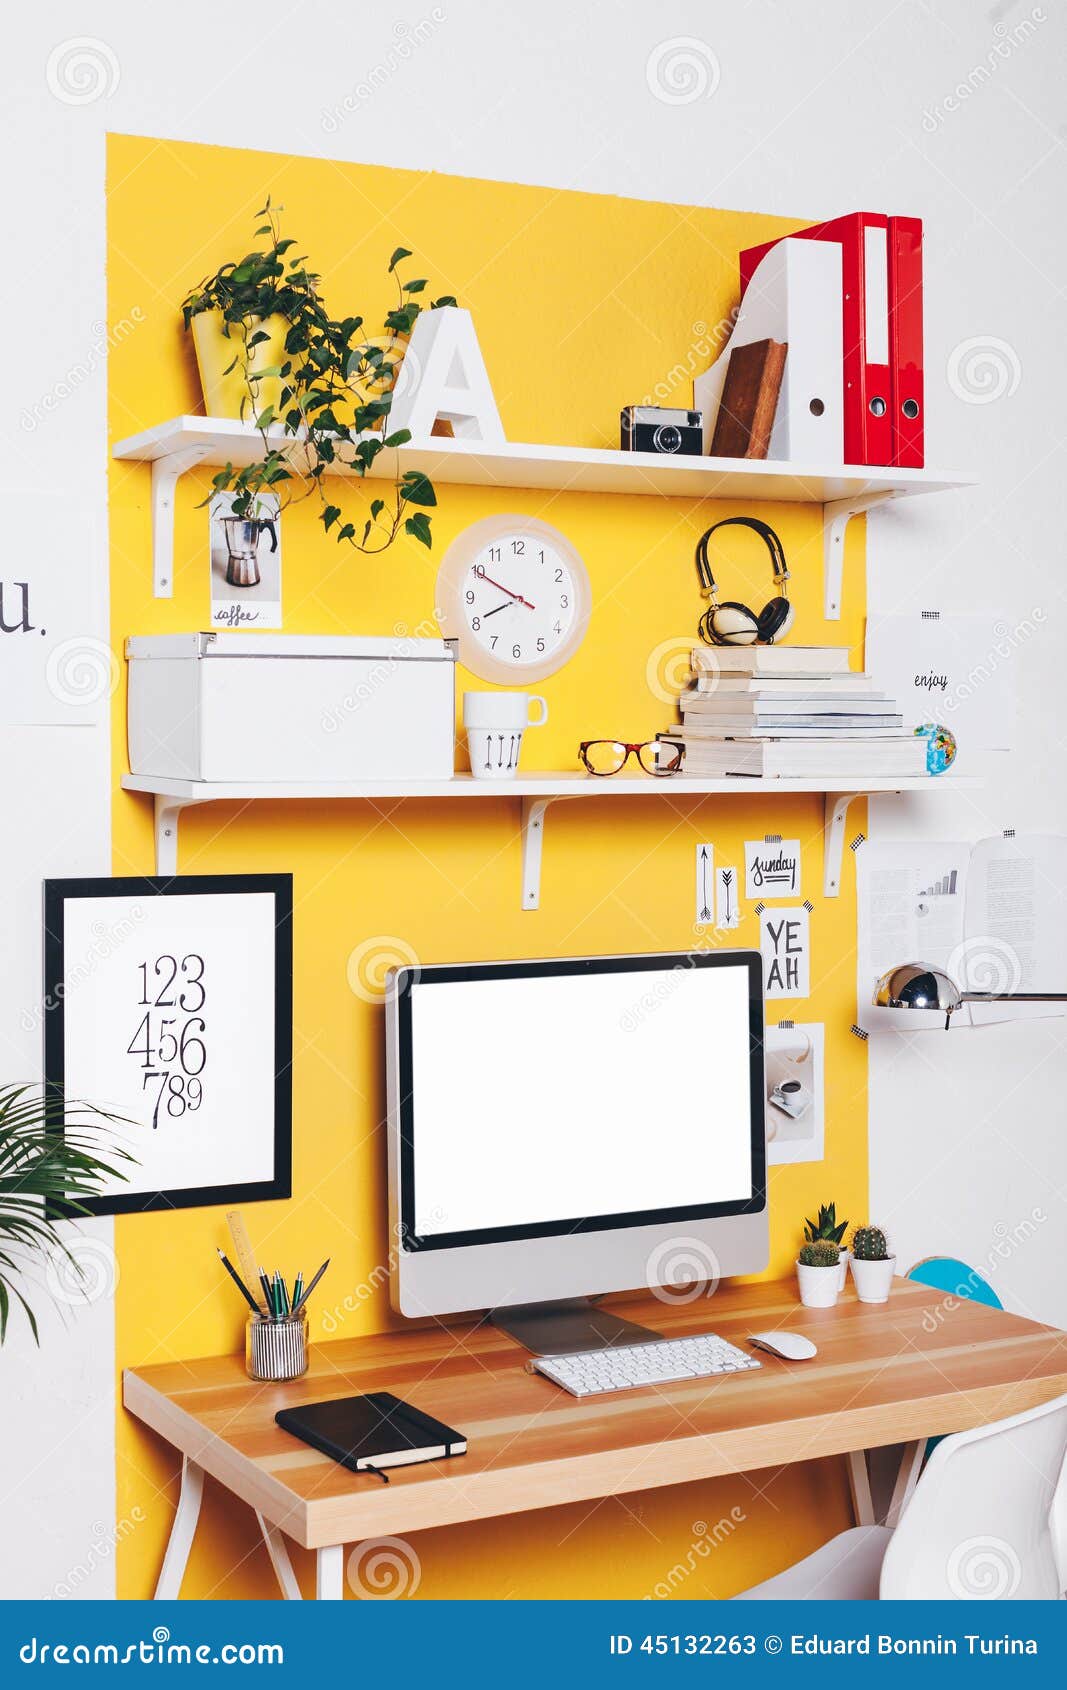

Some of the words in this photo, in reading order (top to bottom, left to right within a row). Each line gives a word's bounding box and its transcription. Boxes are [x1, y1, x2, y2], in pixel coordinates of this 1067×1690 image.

[396, 305, 507, 443] A
[488, 548, 501, 562] 11
[511, 541, 525, 555] 12
[538, 551, 544, 564] 1
[471, 564, 486, 579] 10
[554, 568, 563, 583] 2
[466, 590, 475, 604] 9
[560, 595, 569, 608] 3
[471, 616, 481, 631] 8
[553, 620, 562, 634] 4
[490, 636, 499, 650] 7
[536, 638, 545, 652] 5
[512, 644, 521, 658] 6
[914, 670, 949, 691] enjoy
[766, 920, 803, 955] YE
[766, 957, 799, 990] AH
[137, 954, 206, 1012] 123
[127, 1011, 206, 1076] 456
[143, 1071, 203, 1129] 789
